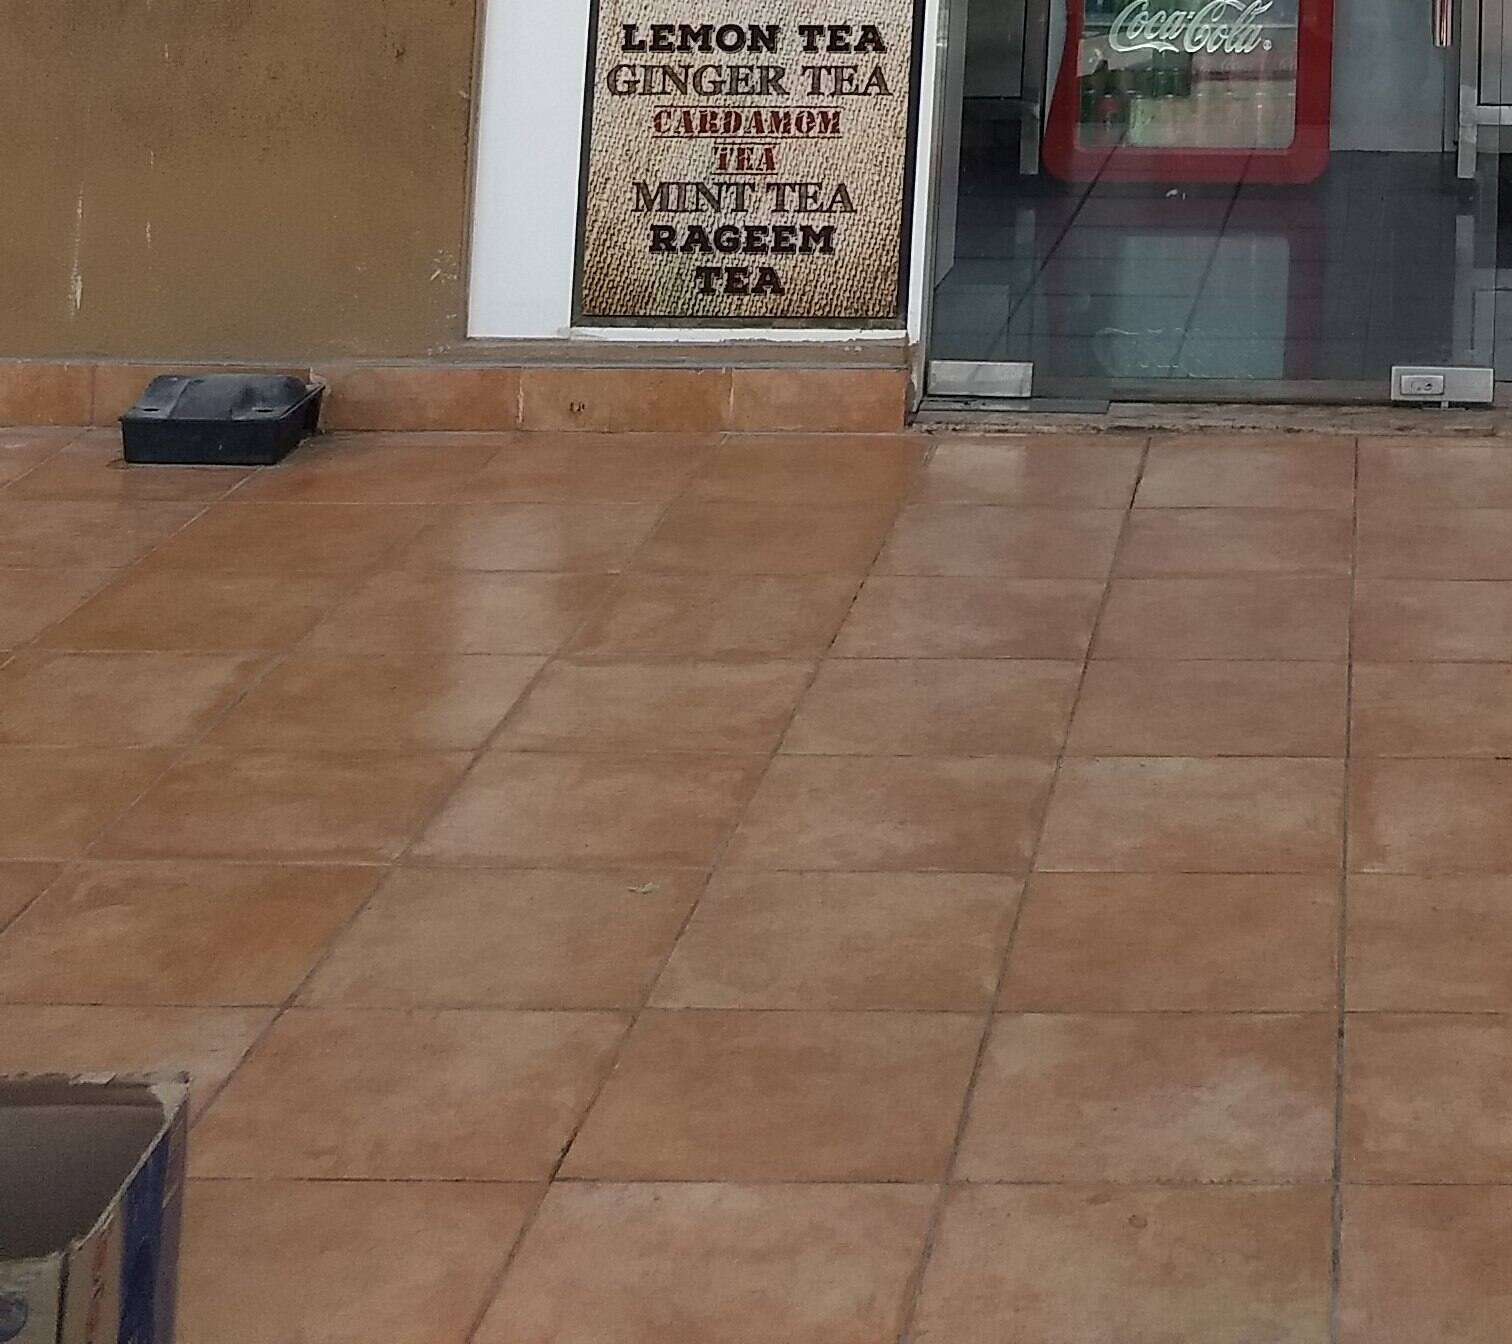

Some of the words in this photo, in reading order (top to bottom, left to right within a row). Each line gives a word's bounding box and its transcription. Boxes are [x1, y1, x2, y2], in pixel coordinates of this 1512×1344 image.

[621, 24, 780, 53] LEMON
[799, 24, 886, 52] TEA
[606, 64, 789, 96] GINGER
[802, 65, 893, 96] TEA
[653, 111, 842, 134] CARDAMOM
[715, 146, 777, 171] TEA
[633, 181, 757, 212] MINT
[769, 182, 857, 212] TEA
[649, 224, 835, 255] RAGEEM
[694, 266, 785, 295] TEA
